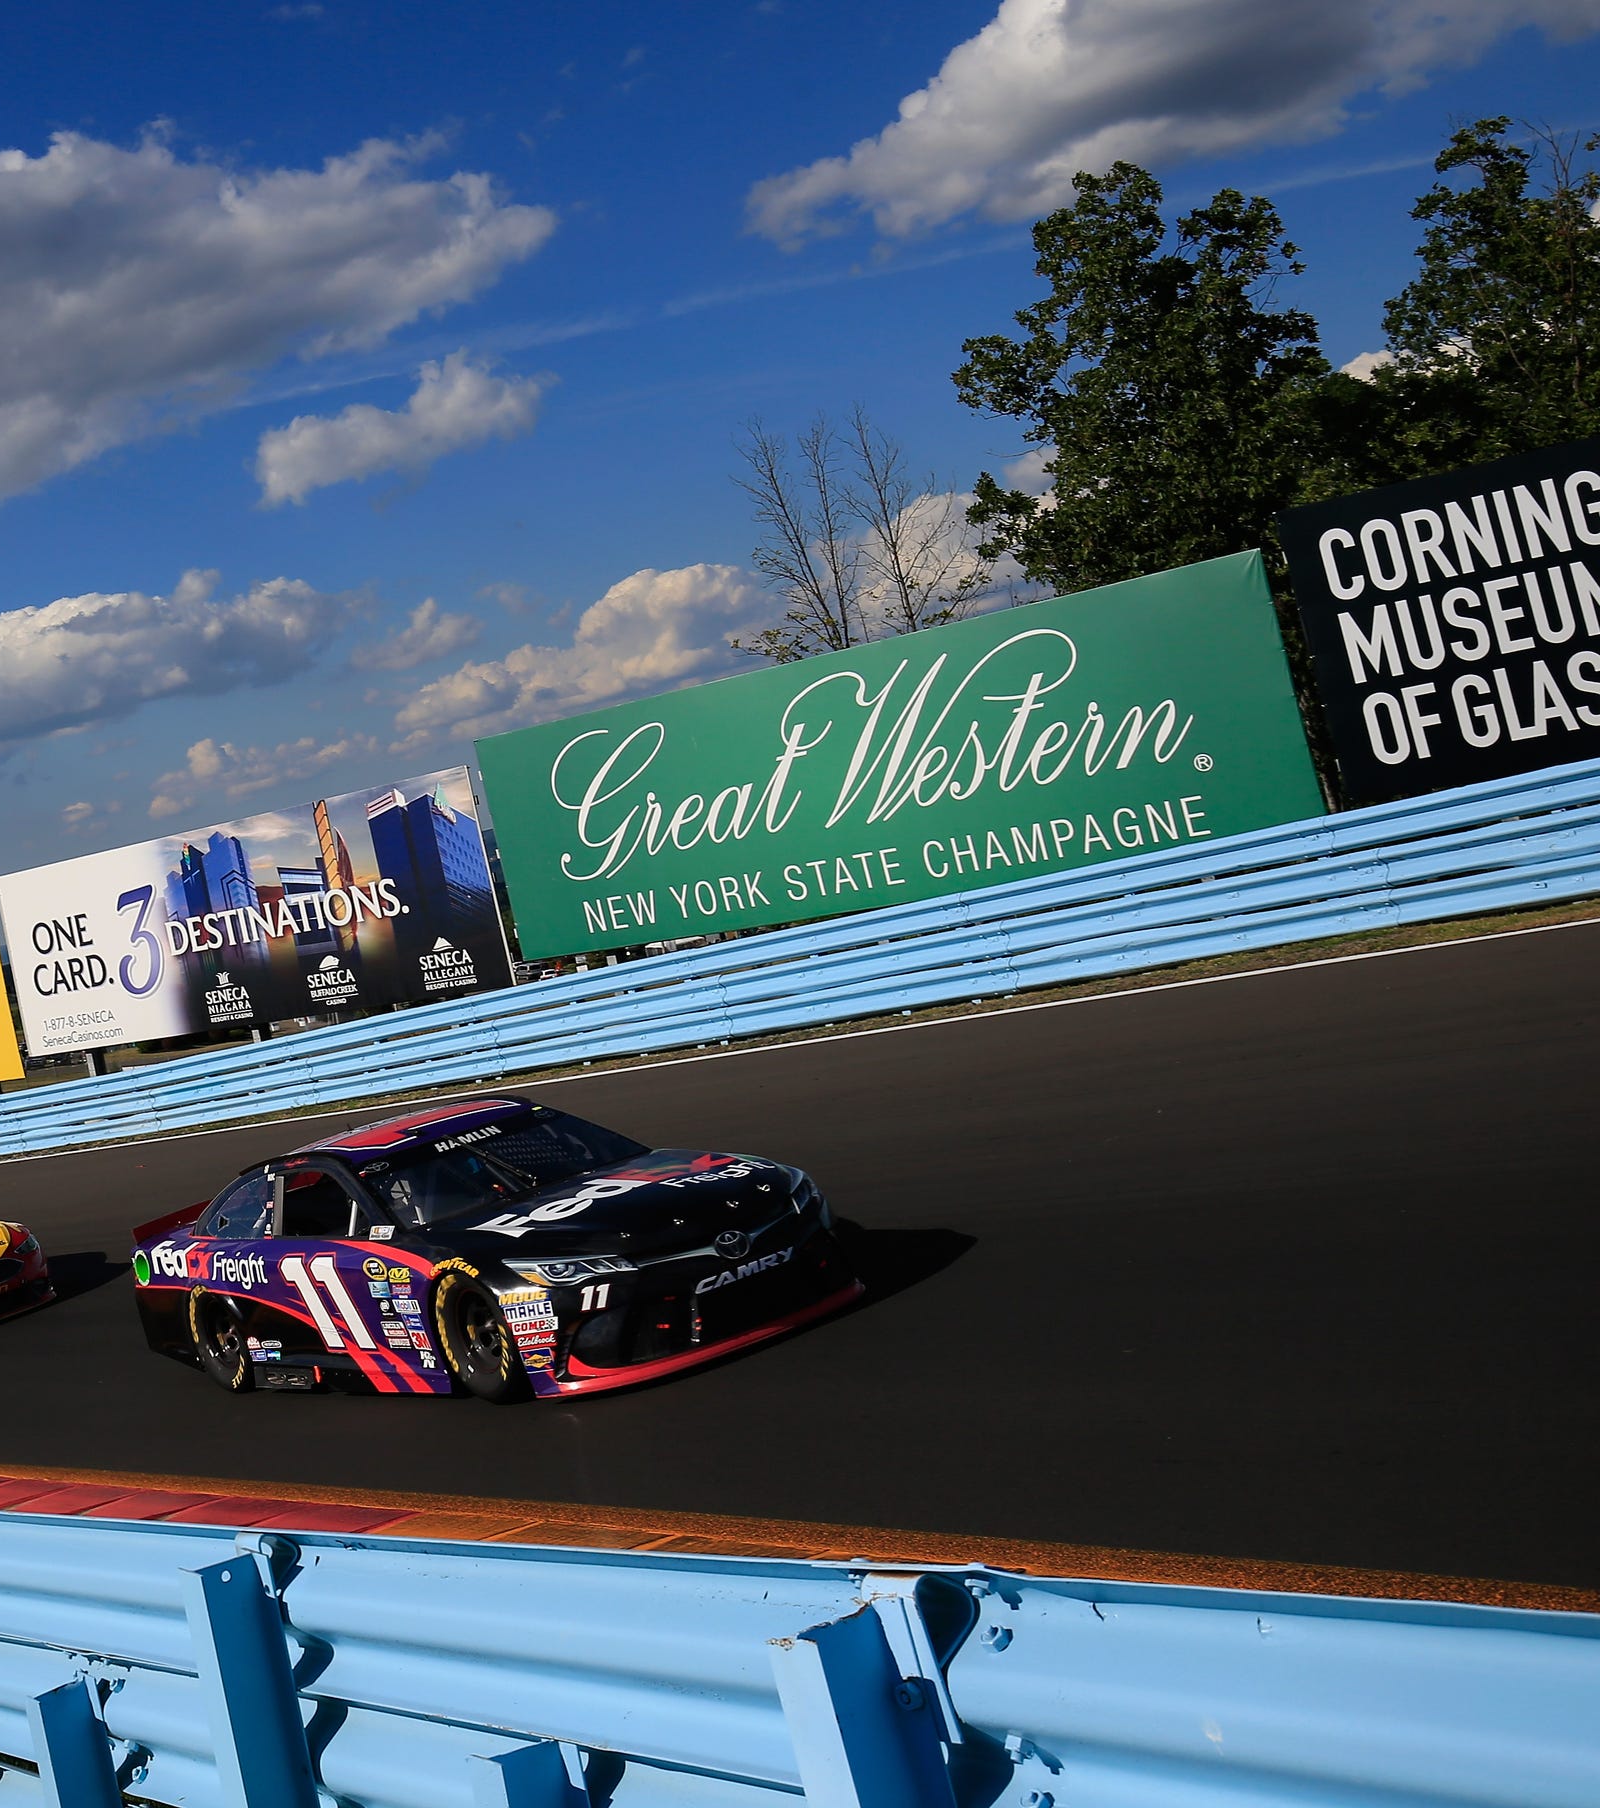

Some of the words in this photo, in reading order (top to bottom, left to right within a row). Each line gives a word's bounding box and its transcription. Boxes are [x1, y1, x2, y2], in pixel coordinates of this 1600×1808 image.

[1319, 470, 1600, 600] CORNING
[1362, 682, 1441, 765] OF
[1451, 651, 1600, 748] GLAS
[551, 722, 808, 881] Great
[781, 628, 1194, 829] Western
[582, 890, 656, 934] NEW
[669, 871, 771, 918] YORK
[783, 847, 905, 900] STATE
[922, 795, 1212, 879] CHAMPAGNE
[32, 913, 93, 954] ONE
[116, 884, 161, 995] 3
[164, 878, 410, 957] DESTINATIONS.
[419, 948, 473, 971] SENECA
[423, 964, 475, 982] ALLEGANY
[33, 954, 115, 996] CARD.
[306, 968, 356, 989] SENECA
[205, 986, 250, 1005] SENECA
[207, 1000, 252, 1015] NIAGARA
[43, 1009, 116, 1032] 1-877-8-SENECA
[42, 1026, 124, 1048] SenecaCasinos.com
[434, 1125, 502, 1153] HAMLIN
[466, 1152, 737, 1238] FedEx
[150, 1240, 215, 1279] FedEx
[211, 1251, 268, 1290] Freight
[695, 1247, 794, 1294] CAMRY
[278, 1252, 378, 1352] 11
[498, 1289, 549, 1306] MOOG
[504, 1302, 552, 1320] MAHLE
[580, 1283, 611, 1312] 11
[513, 1320, 546, 1333] COMP
[517, 1333, 556, 1347] Edelbrock
